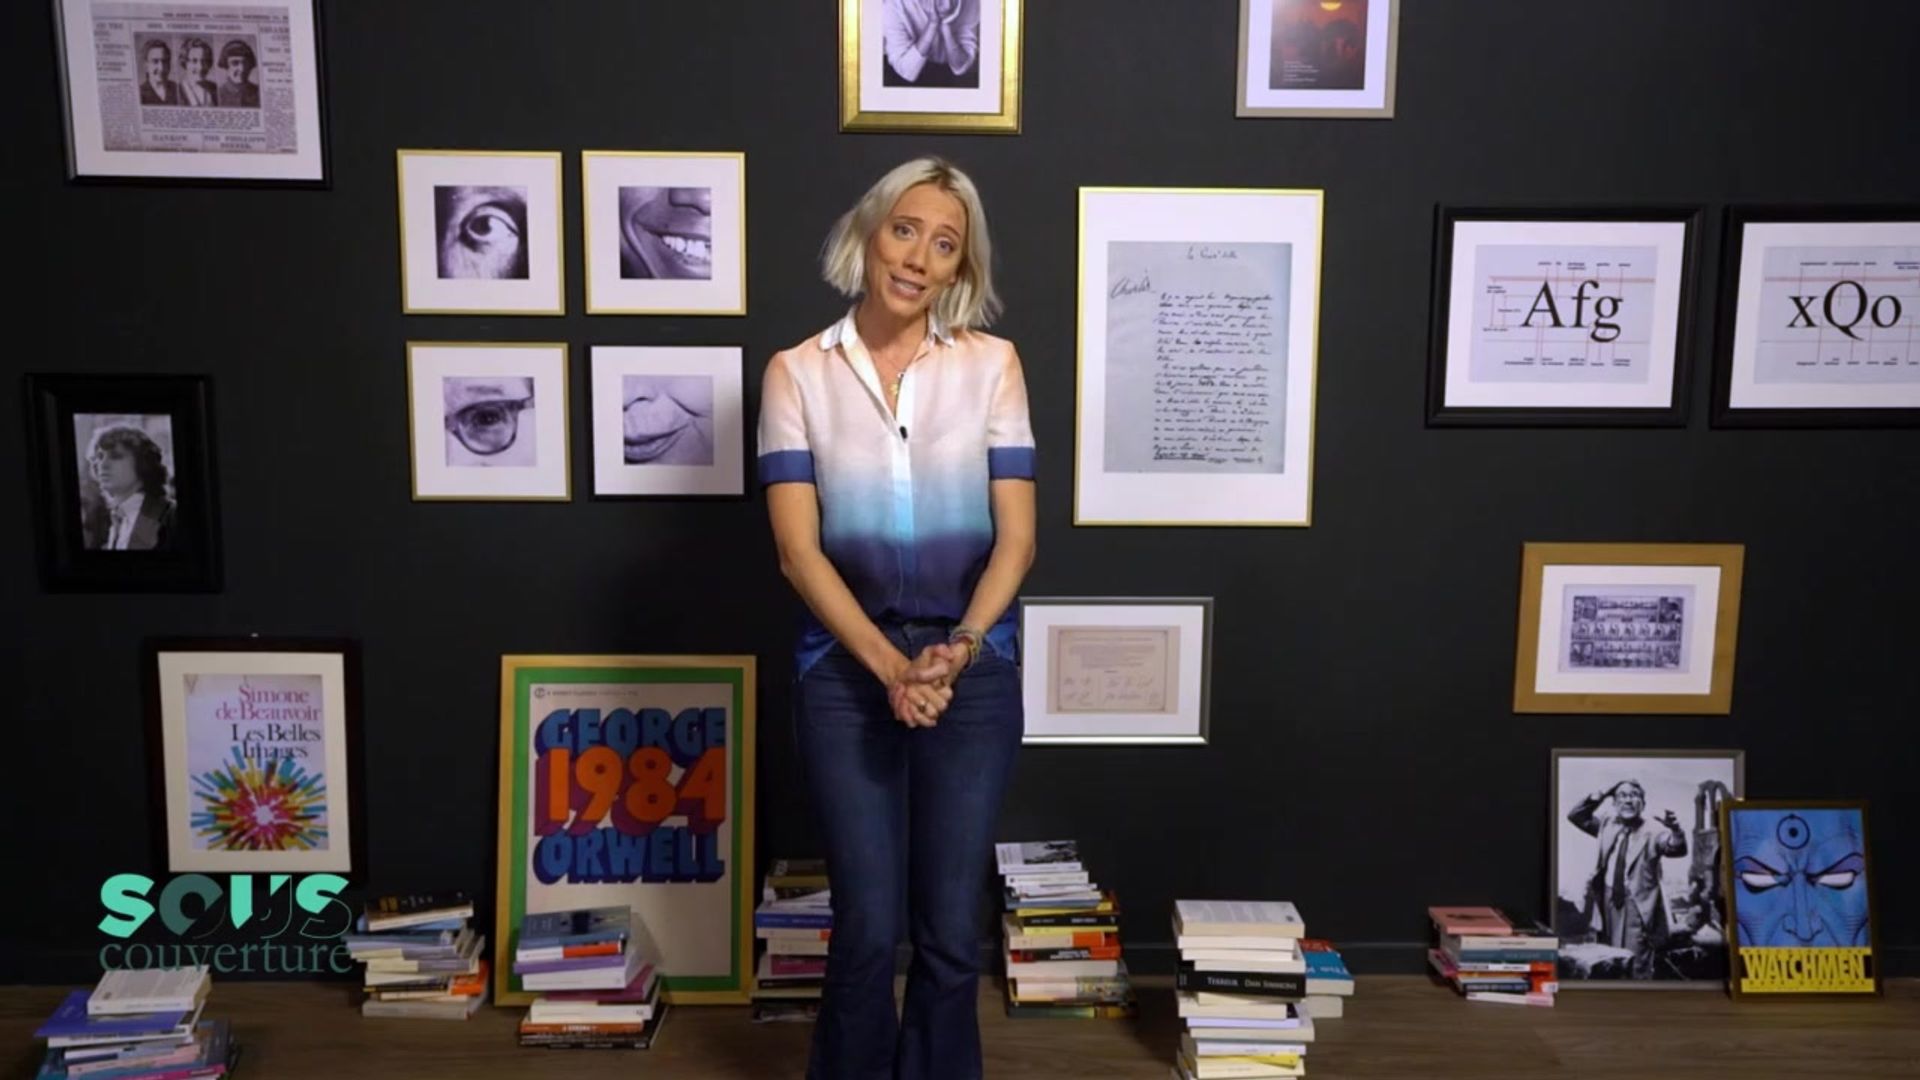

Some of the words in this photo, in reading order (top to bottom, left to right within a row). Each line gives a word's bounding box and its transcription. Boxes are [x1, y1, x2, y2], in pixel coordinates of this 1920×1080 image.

[1519, 279, 1624, 343] Afg
[1786, 280, 1902, 342] xQo
[215, 702, 237, 720] de
[240, 702, 322, 721] Beauvoir
[239, 684, 310, 703] Simone
[231, 723, 265, 742] Les
[268, 723, 321, 742] Belles
[535, 707, 727, 758] GEORGE
[537, 745, 727, 834] 1984
[533, 826, 726, 885] ORWELL
[1743, 951, 1866, 980] WATCHMEN
